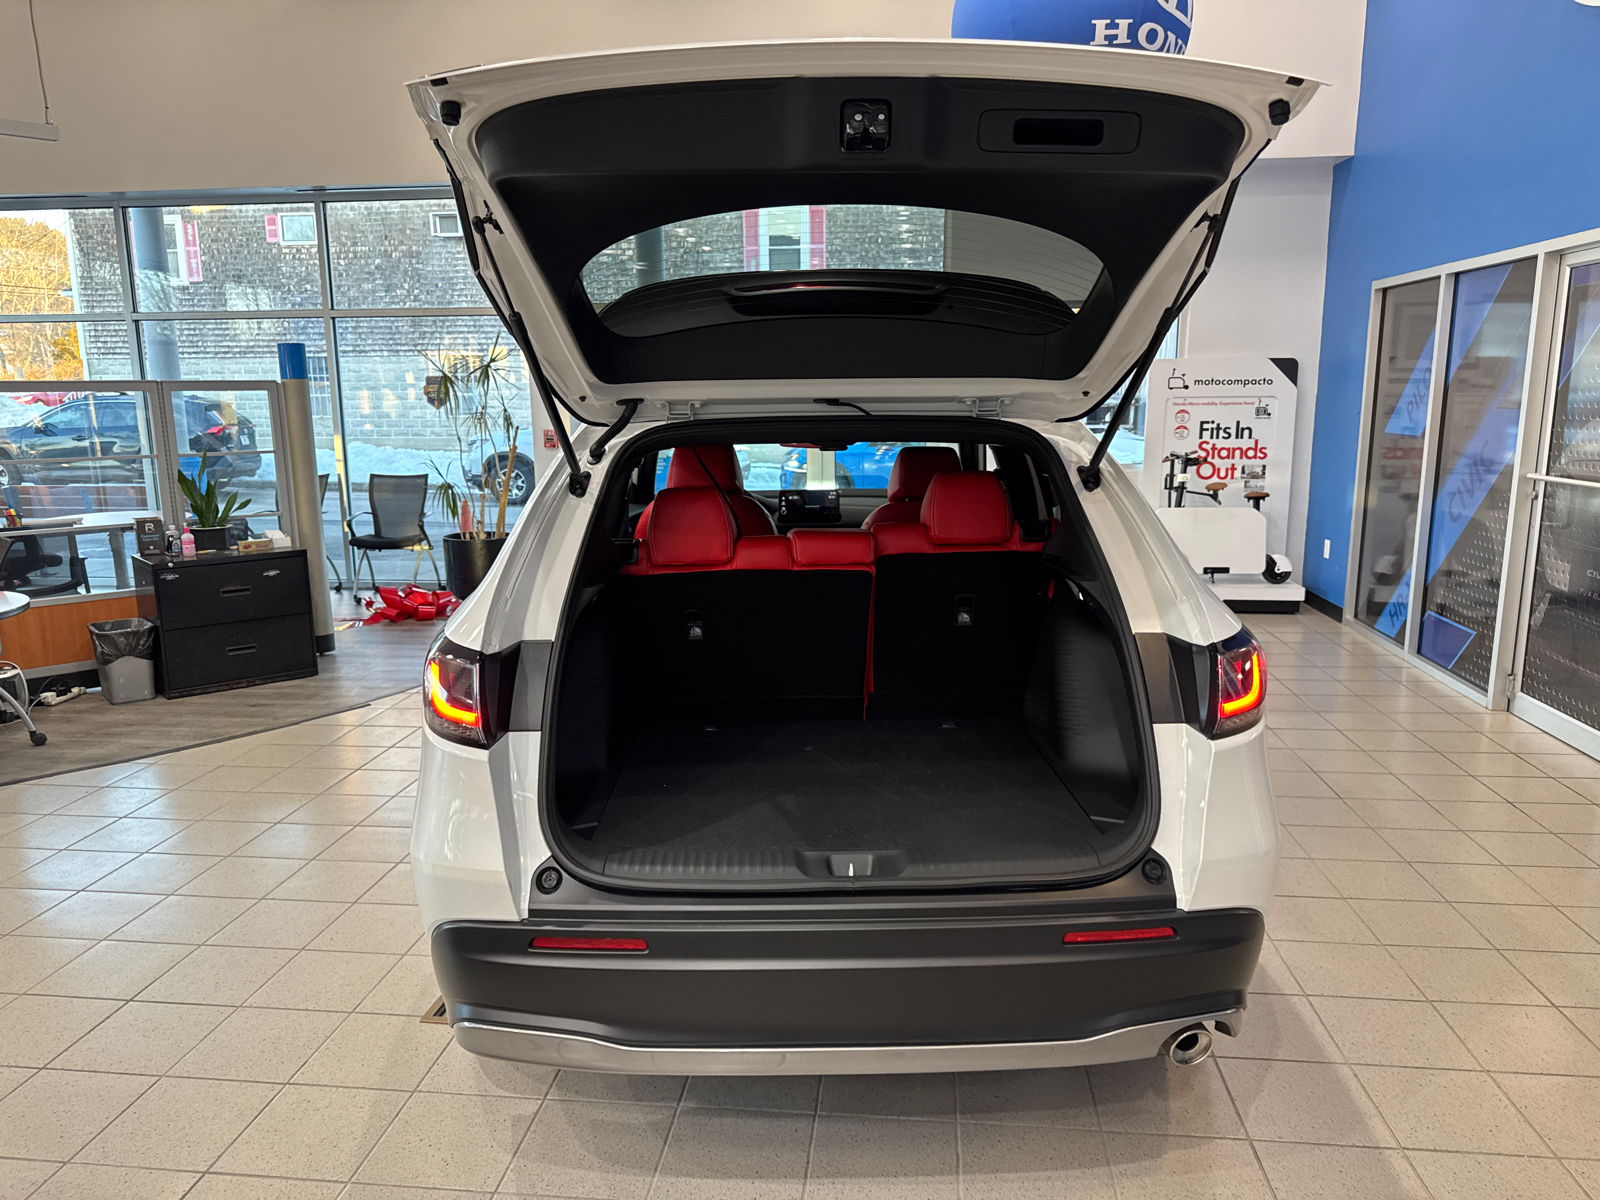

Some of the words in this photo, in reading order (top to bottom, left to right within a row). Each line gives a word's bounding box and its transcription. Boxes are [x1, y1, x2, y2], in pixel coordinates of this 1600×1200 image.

[1089, 18, 1186, 55] HON
[1193, 377, 1274, 388] motocompacto
[1406, 366, 1432, 424] PILO
[1199, 420, 1232, 439] Fits
[1197, 439, 1267, 459] Stands
[1447, 440, 1494, 523] CIVIC
